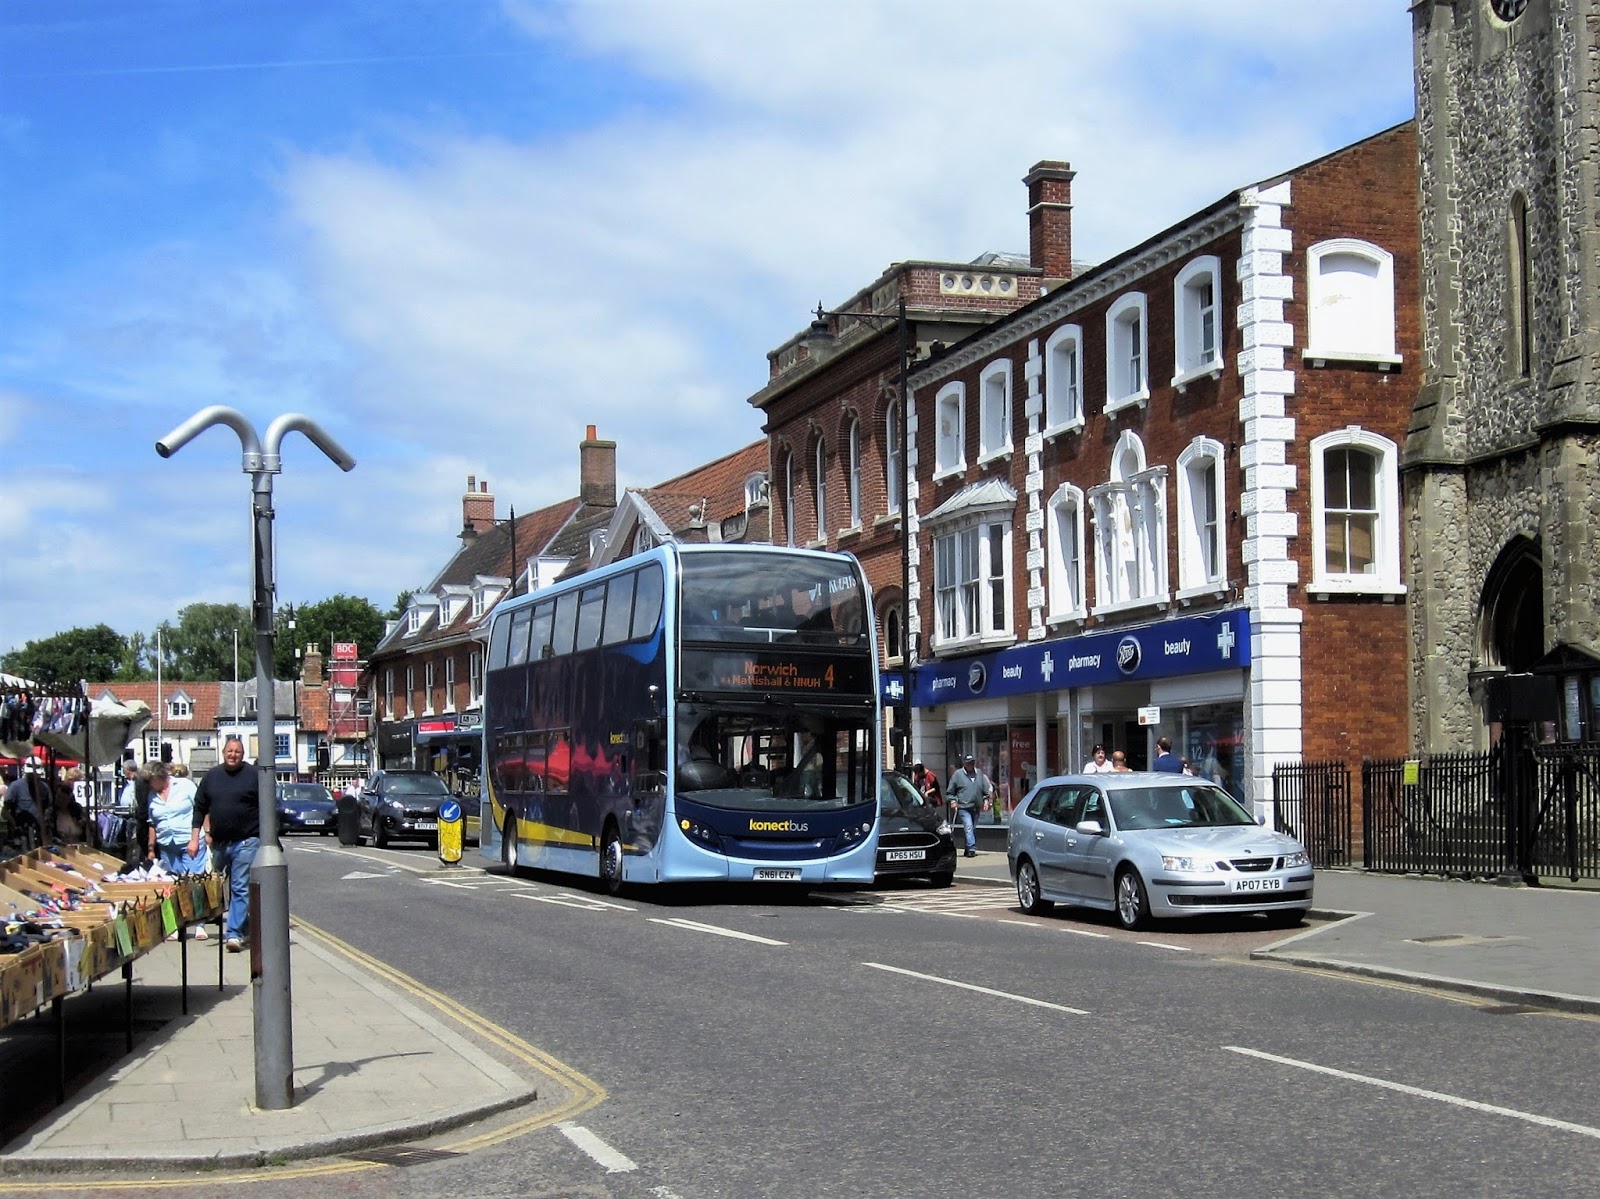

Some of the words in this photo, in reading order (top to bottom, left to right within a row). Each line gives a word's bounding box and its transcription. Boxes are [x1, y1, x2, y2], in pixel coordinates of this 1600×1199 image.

[1118, 643, 1135, 667] Boots
[1164, 638, 1191, 656] beauty
[744, 661, 798, 677] Norwich
[1068, 654, 1101, 672] pharmacy
[824, 664, 835, 689] 4
[1002, 664, 1023, 679] beauty
[932, 676, 957, 692] pharmacy
[749, 818, 809, 833] konectbus
[759, 870, 778, 880] SN61
[779, 870, 796, 880] CZV
[1236, 880, 1261, 891] AP07
[1262, 879, 1280, 890] EYB
